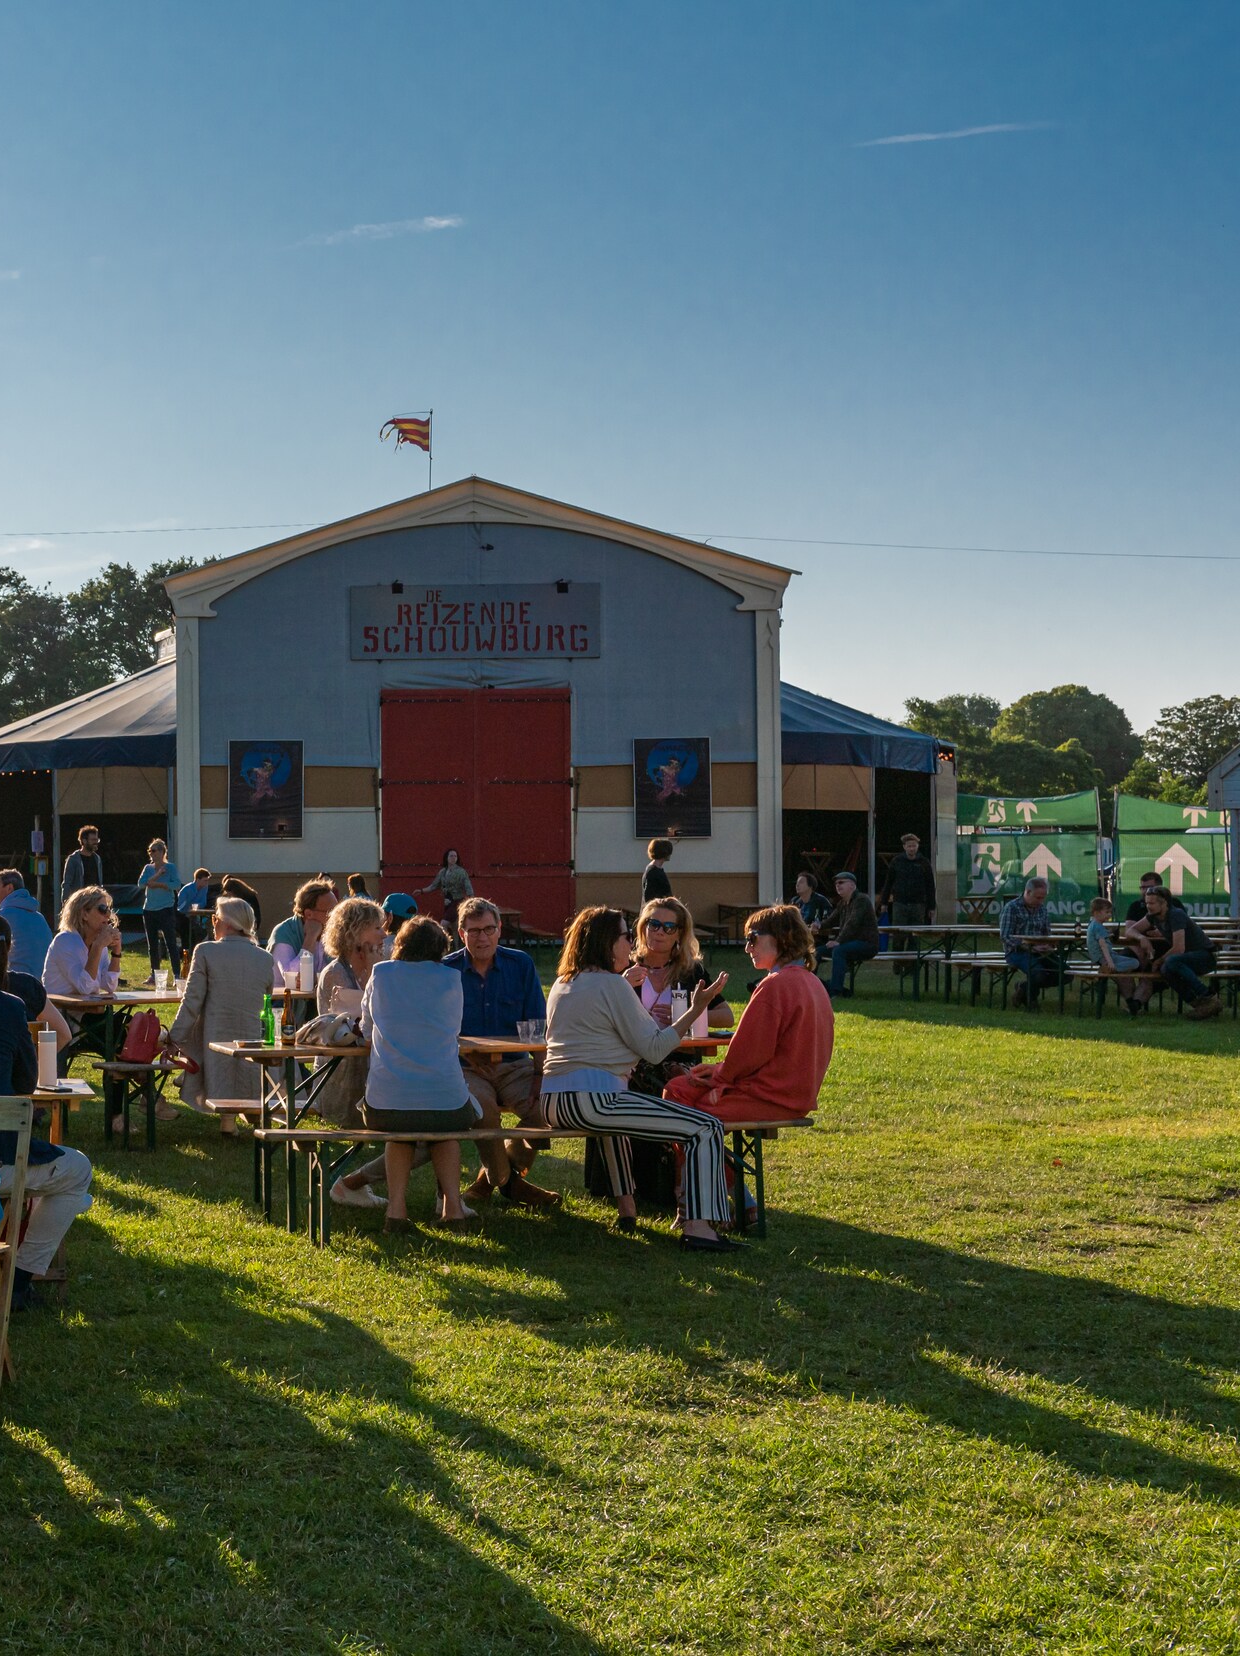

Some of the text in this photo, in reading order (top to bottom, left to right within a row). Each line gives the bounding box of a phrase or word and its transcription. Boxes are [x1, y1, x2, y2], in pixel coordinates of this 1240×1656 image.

[426, 590, 442, 602] DE
[397, 602, 531, 626] REIZENDE
[363, 624, 588, 653] SCHOUWBURG
